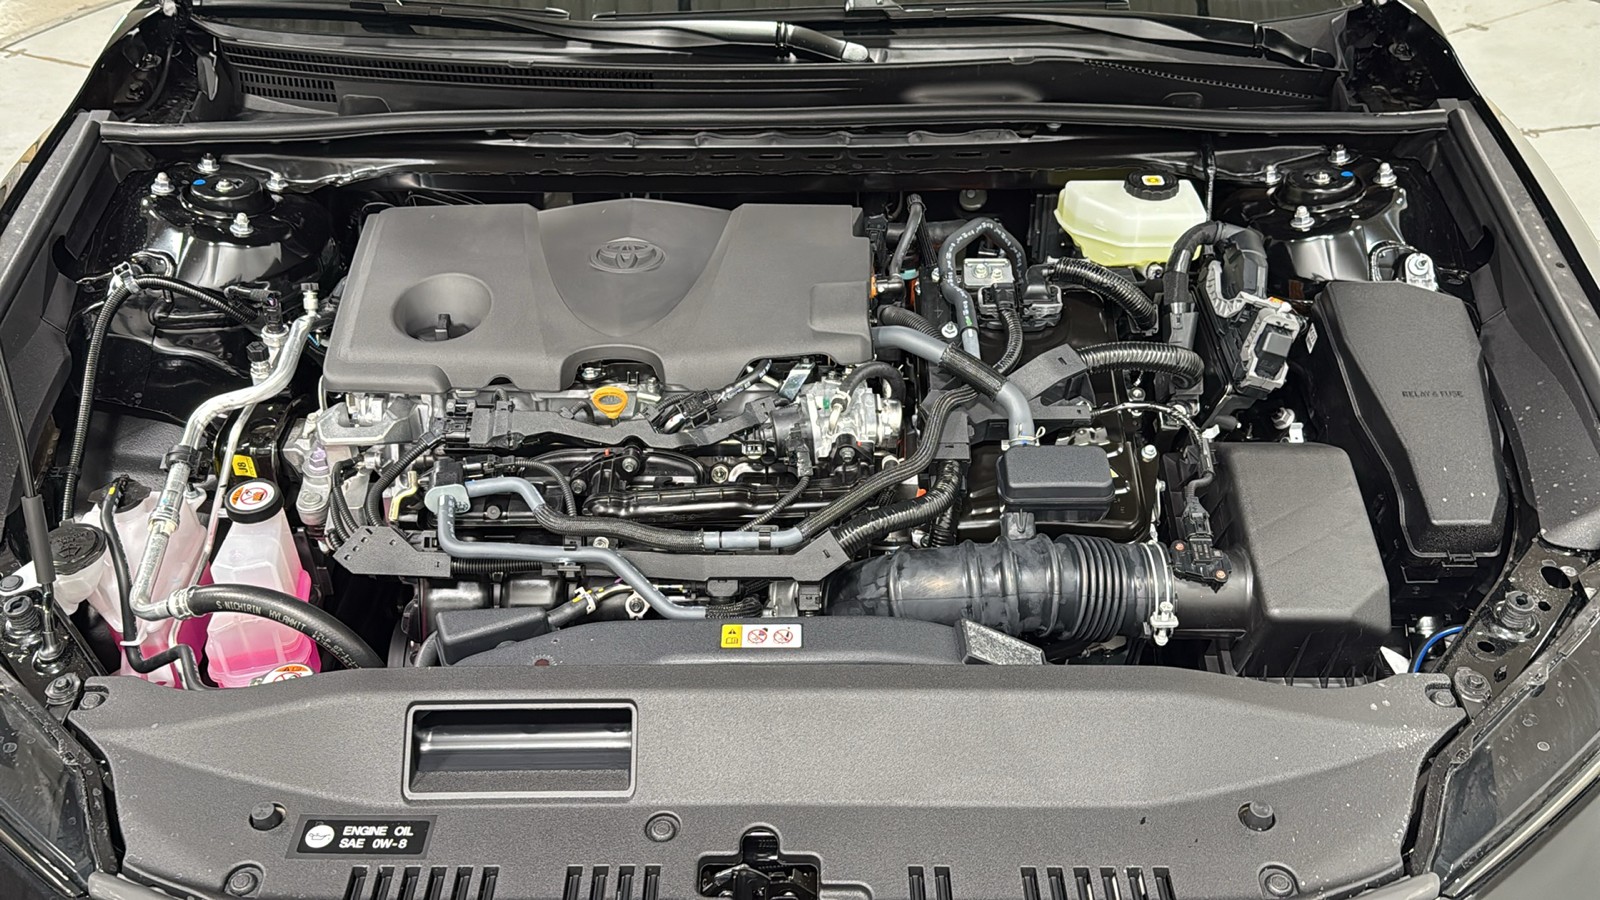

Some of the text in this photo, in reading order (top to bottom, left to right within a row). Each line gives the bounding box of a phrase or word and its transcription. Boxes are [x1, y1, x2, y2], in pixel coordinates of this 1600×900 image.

[1440, 390, 1464, 398] FUSE
[343, 826, 414, 836] ENGINE OIL
[339, 838, 407, 848] SAE 0W-8
